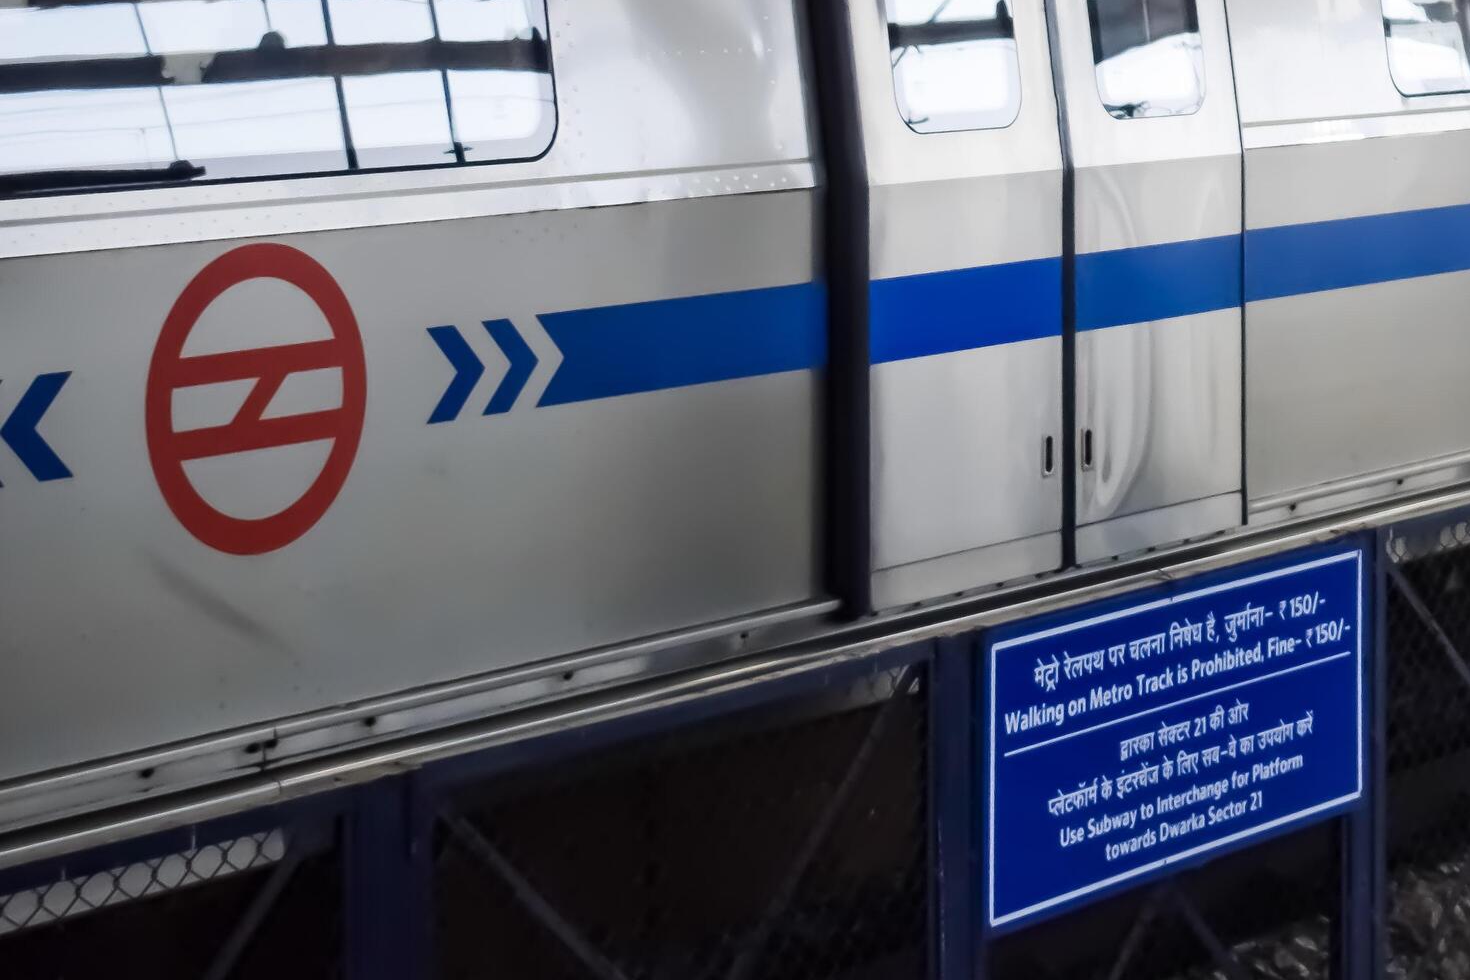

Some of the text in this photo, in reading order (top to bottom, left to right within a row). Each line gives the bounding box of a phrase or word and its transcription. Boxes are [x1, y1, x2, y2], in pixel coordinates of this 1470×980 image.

[1005, 702, 1065, 735] Walking
[1068, 697, 1087, 717] on
[1089, 686, 1133, 710] Metro
[1136, 666, 1174, 696] Track
[1177, 663, 1188, 684] is
[1191, 641, 1265, 681] Prohibited,
[1268, 636, 1302, 659] Fine-
[1034, 654, 1060, 692] मेट्रो
[1063, 651, 1105, 680] रेलपथ
[1109, 644, 1126, 667] पर
[1129, 632, 1166, 661] चलना
[1169, 617, 1203, 651] निषेध
[1206, 611, 1220, 644] है,
[1101, 775, 1113, 801] के
[1162, 755, 1174, 780] के
[1177, 749, 1199, 777] लिए
[1240, 734, 1255, 756] का
[1257, 718, 1295, 750] उपयोग
[1297, 709, 1313, 737] करें
[1120, 698, 1249, 762] द्वारका सेक्टर 21 की ओर
[1060, 754, 1304, 848] Use Subway to Interchange for Platform
[1105, 790, 1263, 861] towards Dwarka Sector 21
